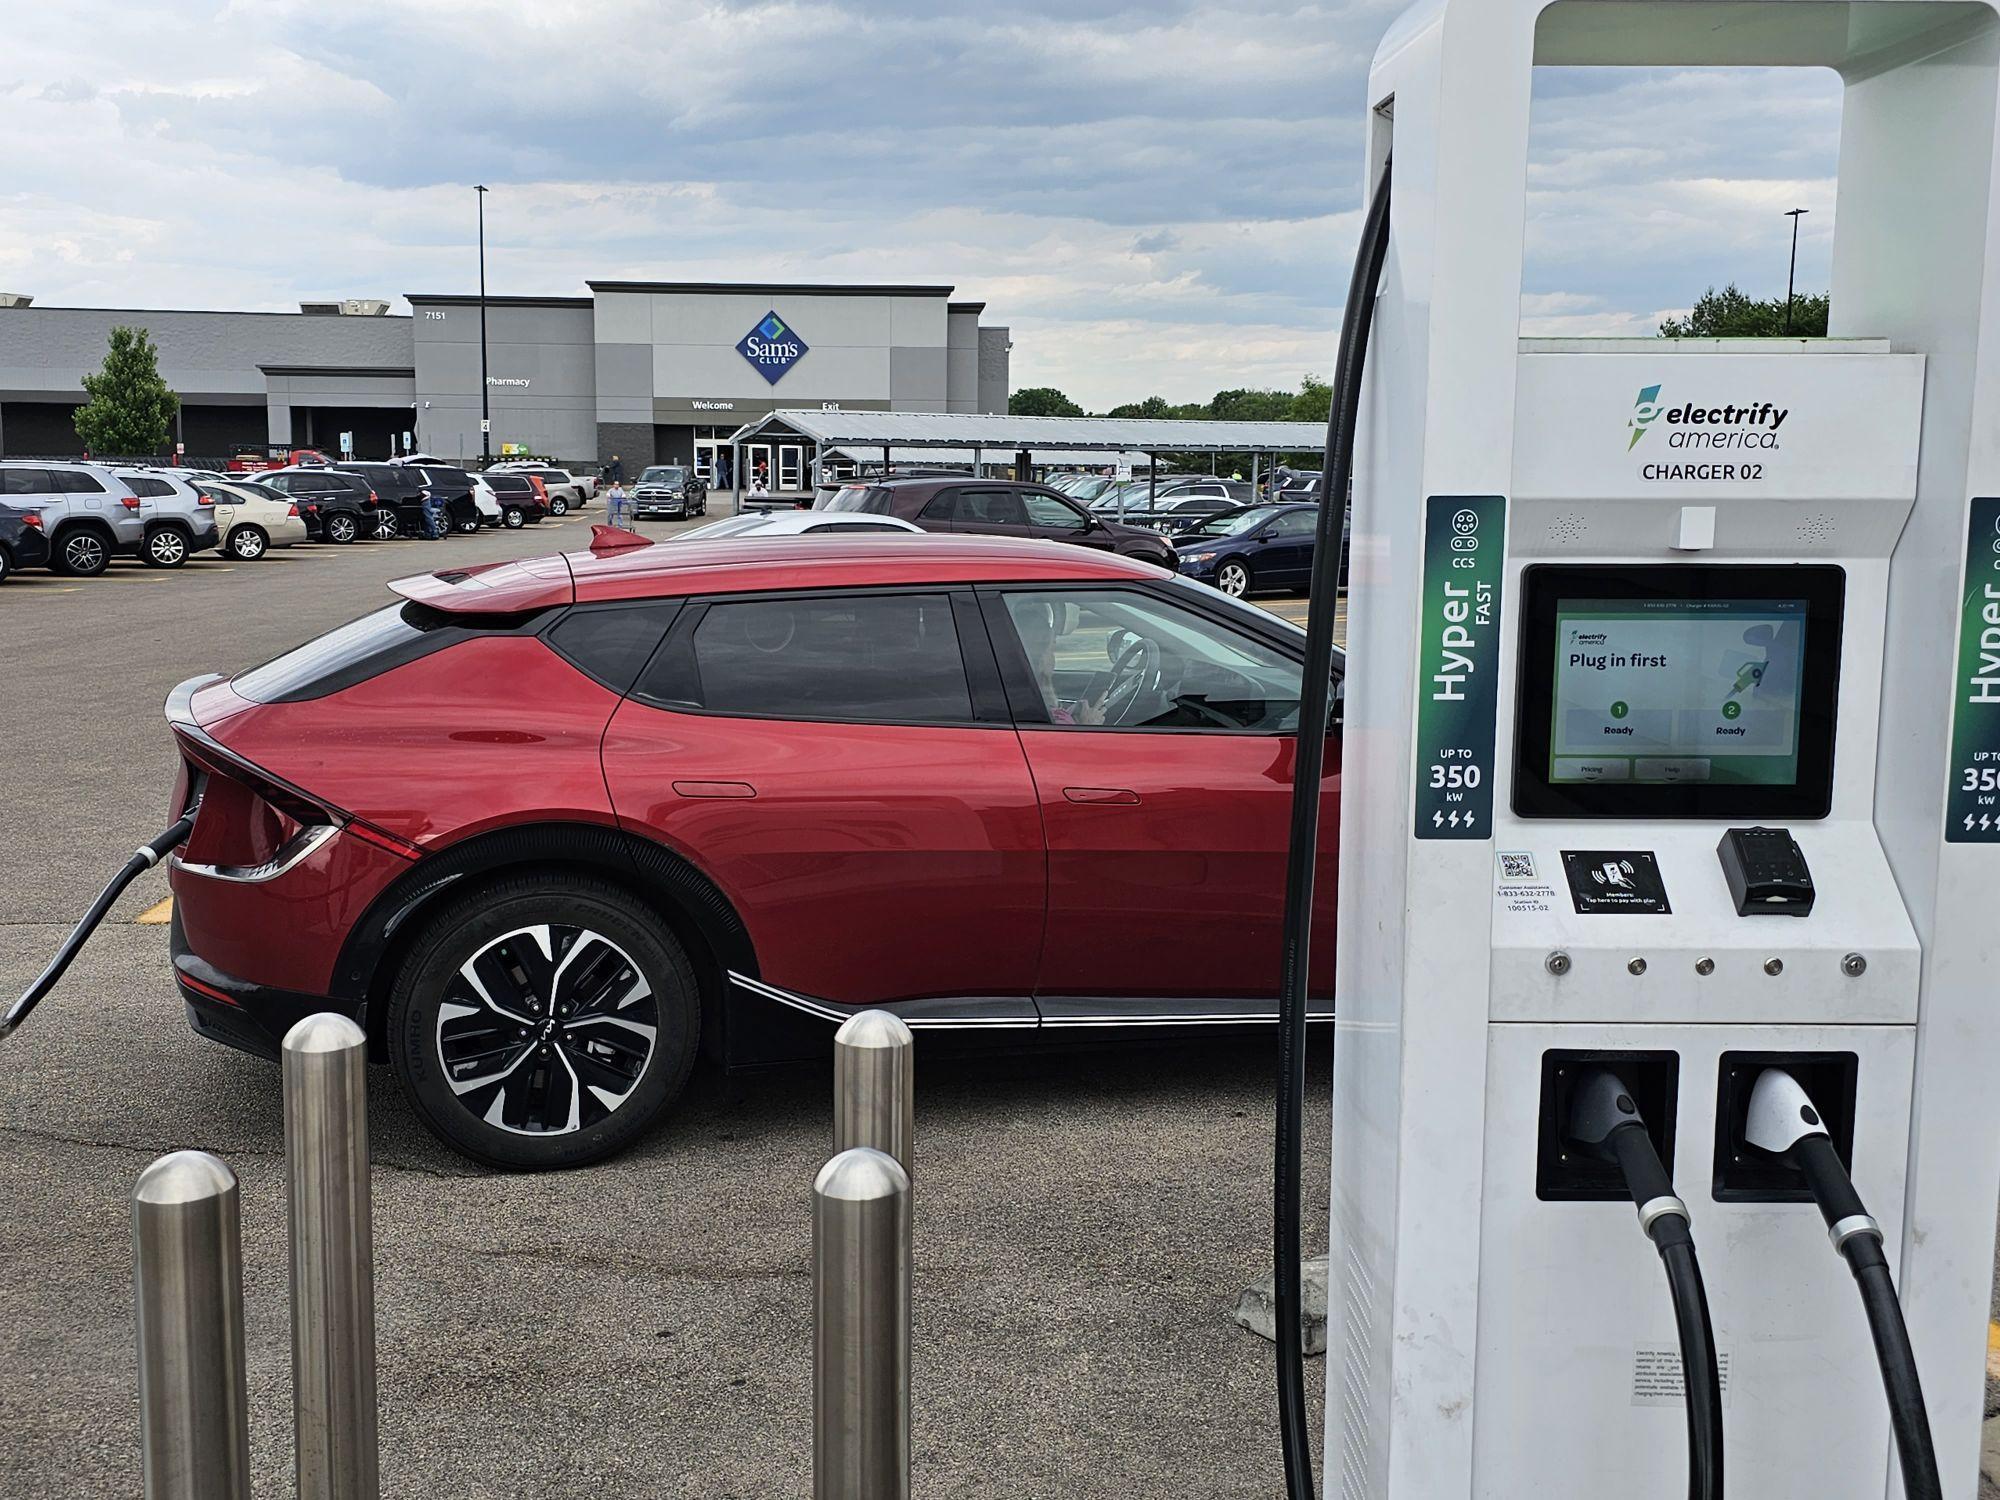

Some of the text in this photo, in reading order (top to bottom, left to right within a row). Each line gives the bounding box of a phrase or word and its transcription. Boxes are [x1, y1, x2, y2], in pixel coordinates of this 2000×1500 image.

[425, 311, 446, 320] 7151
[747, 336, 798, 357] Sam's
[486, 377, 530, 387] Pharmacy
[692, 401, 733, 410] Welcome
[822, 402, 840, 411] Exit
[1666, 402, 1788, 431] electrify
[1643, 464, 1763, 480] CHARGER 02
[1452, 557, 1475, 568] CCS
[1475, 580, 1492, 625] FAST
[1433, 581, 1476, 701] Hyper
[1578, 633, 1607, 641] electrify
[1570, 653, 1667, 671] Plug in first
[1728, 706, 1735, 715] 2
[1604, 726, 1634, 736] Ready
[1716, 727, 1746, 737] Ready
[1440, 749, 1472, 758] UP TO
[1974, 752, 1989, 761] UP
[1429, 764, 1480, 788] 350
[1962, 768, 2000, 791] 35
[1446, 792, 1463, 801] kW
[1978, 795, 1995, 805] kW
